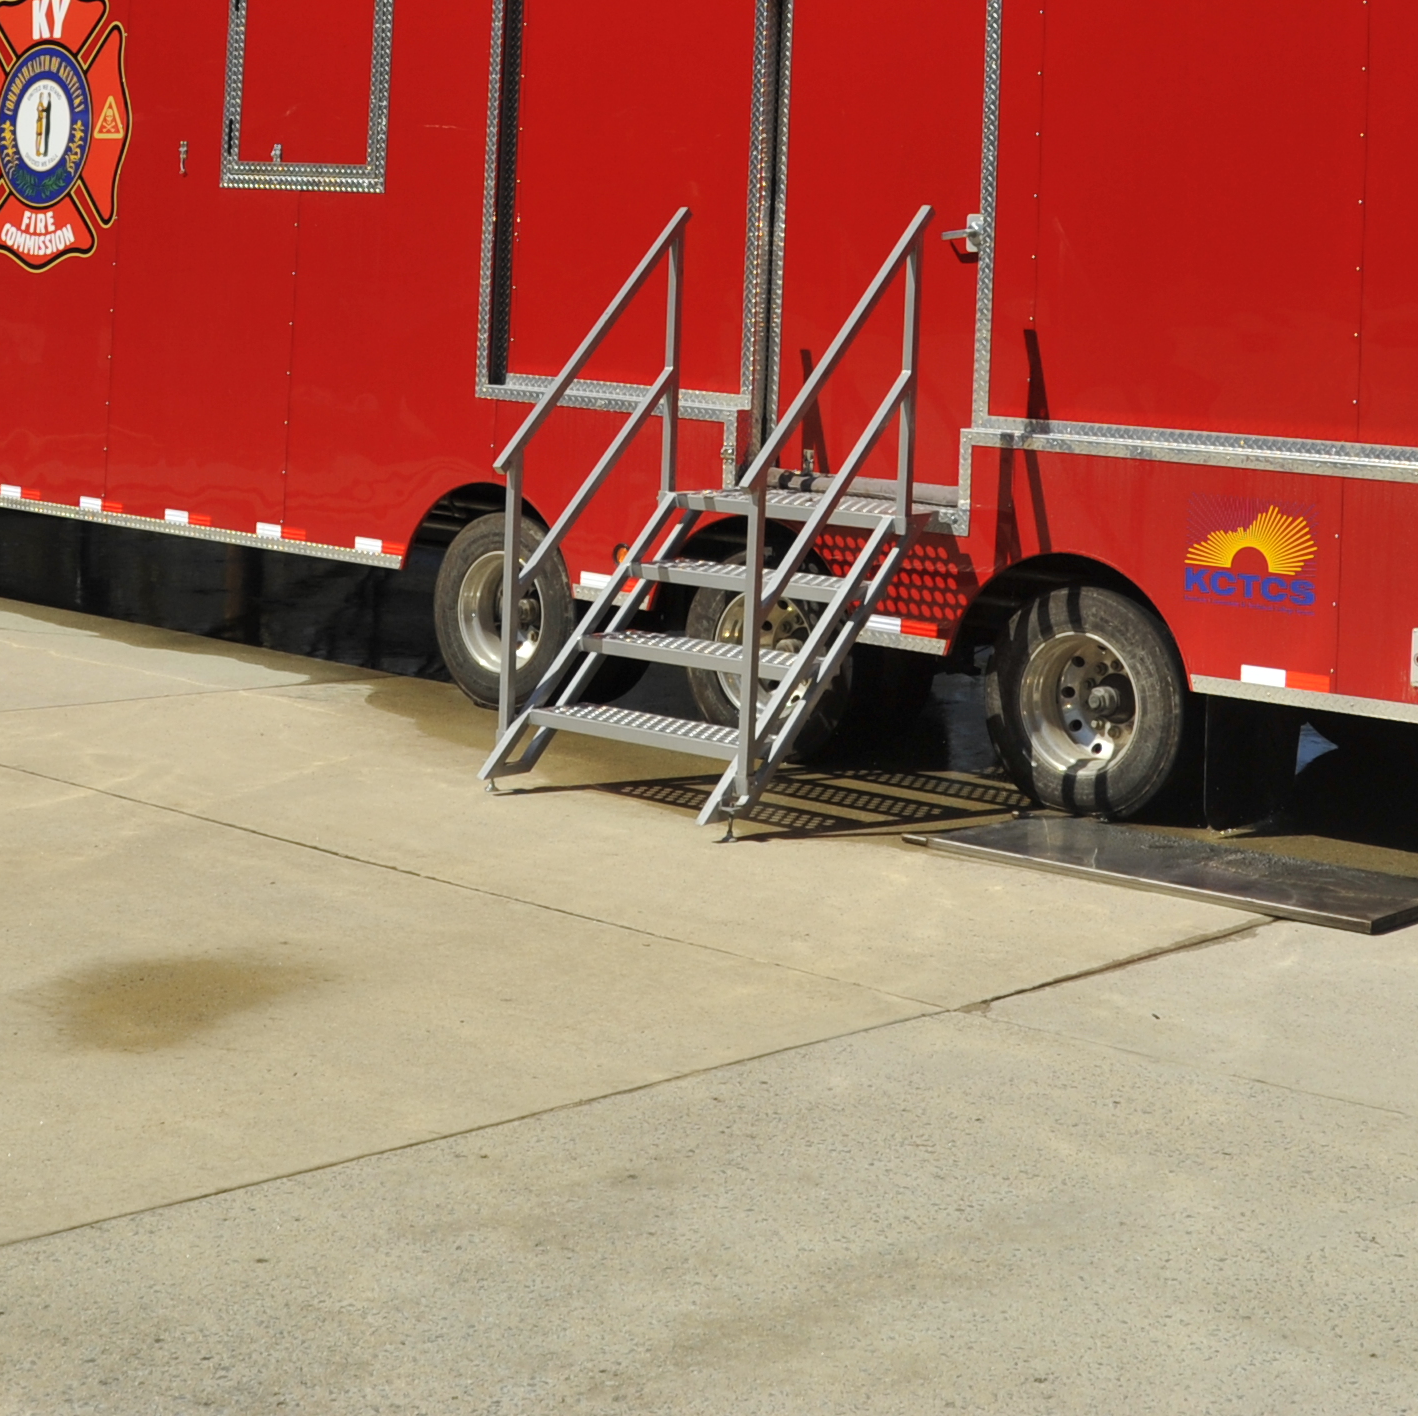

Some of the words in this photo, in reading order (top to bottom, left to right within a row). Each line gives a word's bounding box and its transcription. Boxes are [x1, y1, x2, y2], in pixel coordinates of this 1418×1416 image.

[50, 56, 61, 74] OF
[59, 61, 85, 112] KENTUCKY
[1, 222, 75, 256] COMMISSION
[21, 210, 56, 234] FIRE
[1184, 566, 1316, 606] KCTCS
